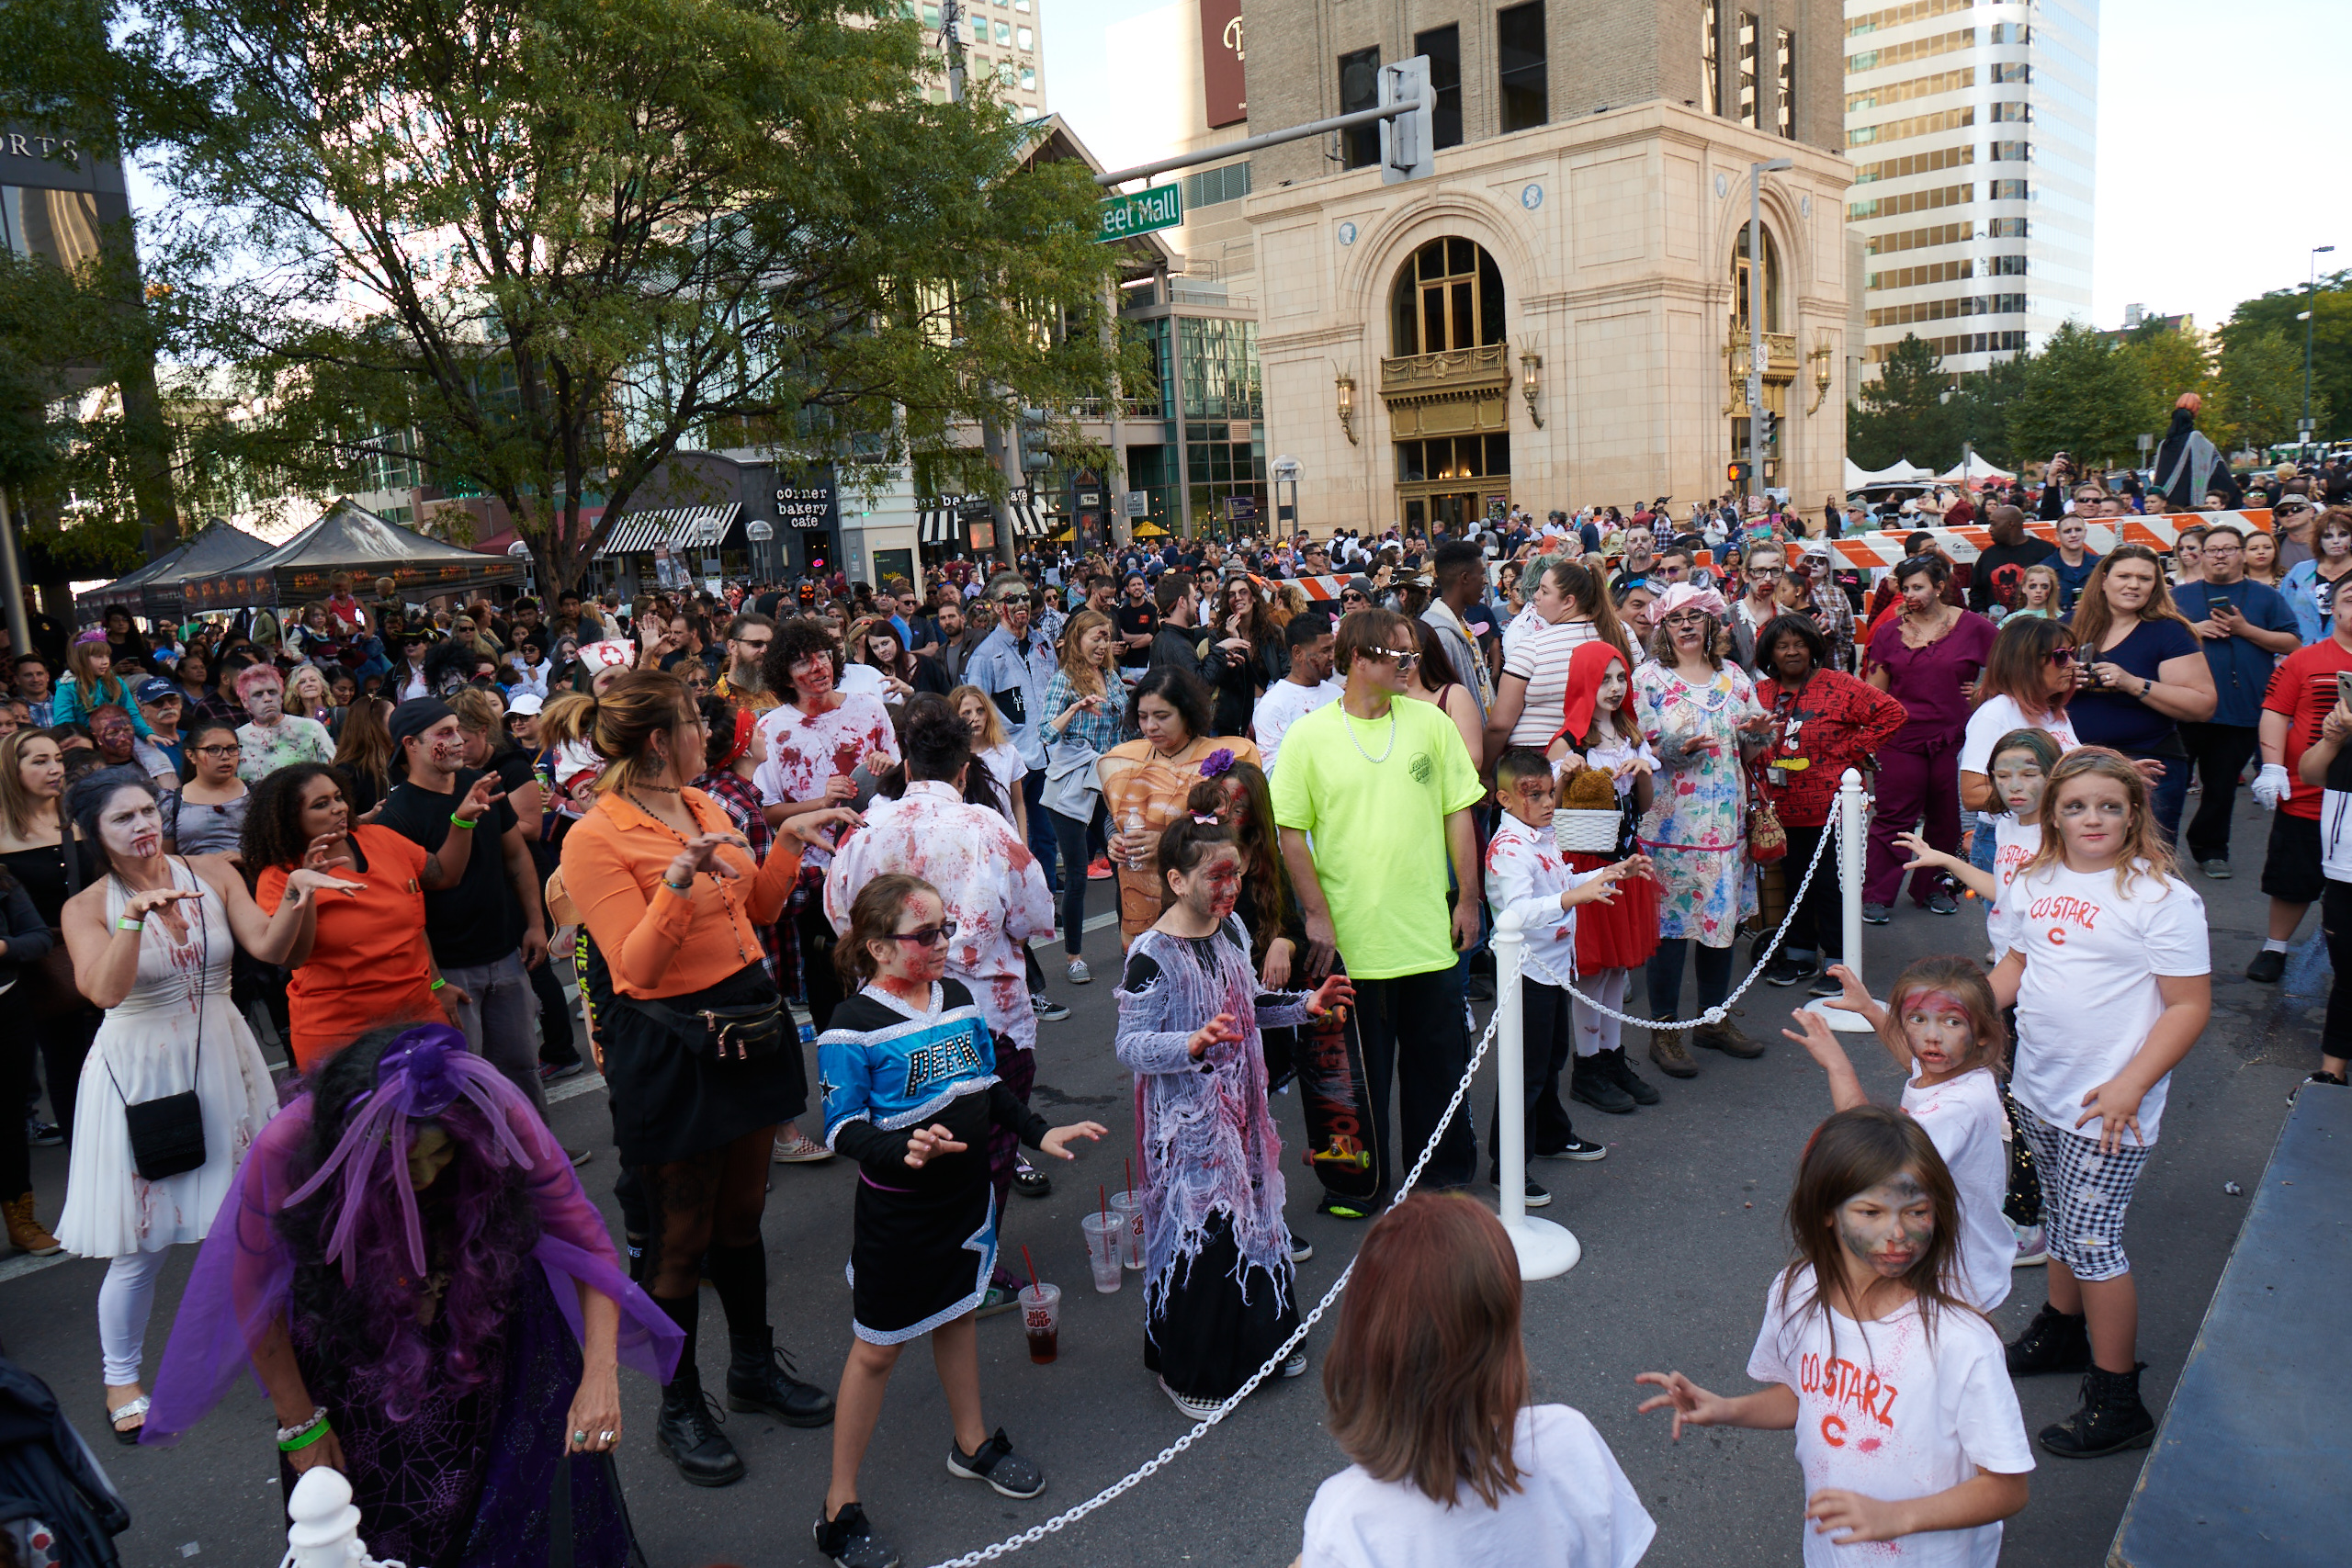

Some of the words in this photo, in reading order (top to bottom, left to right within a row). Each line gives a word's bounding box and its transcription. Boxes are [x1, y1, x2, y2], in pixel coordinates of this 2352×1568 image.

[0, 133, 78, 161] RTS
[1138, 189, 1176, 226] Mall
[776, 488, 827, 500] corner
[777, 502, 828, 516] bakery
[791, 514, 819, 527] cafe
[904, 1032, 982, 1099] PEAK
[1026, 1317, 1052, 1327] GULP
